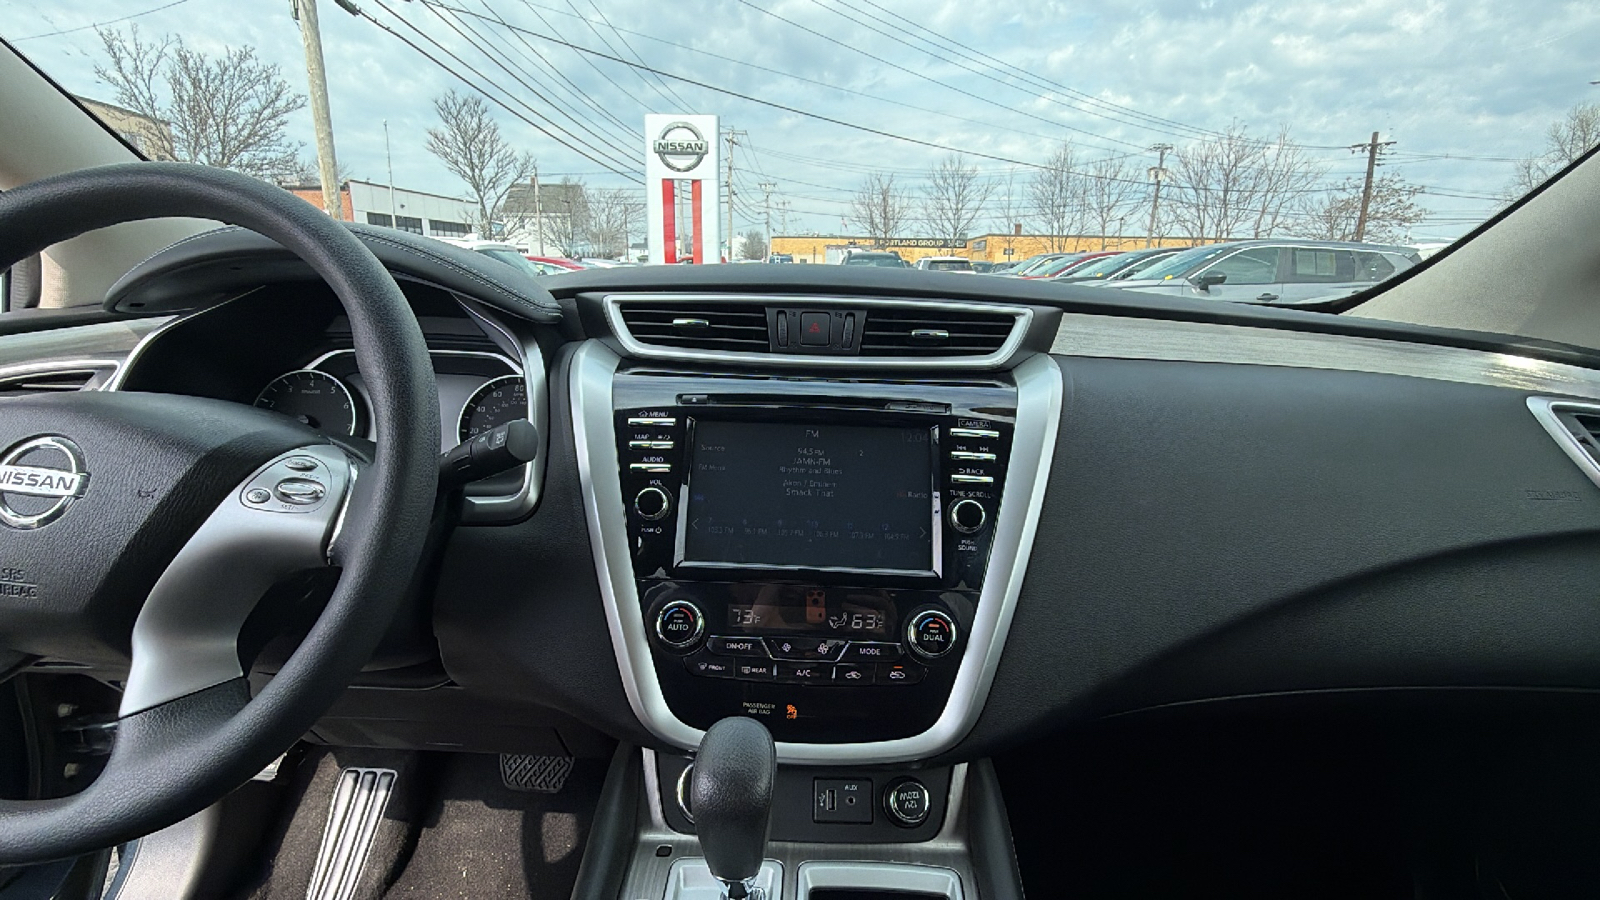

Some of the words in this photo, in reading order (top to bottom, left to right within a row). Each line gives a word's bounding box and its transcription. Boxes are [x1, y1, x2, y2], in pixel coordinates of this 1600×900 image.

[658, 142, 703, 151] NISSAN
[959, 420, 989, 428] CAMERA
[805, 429, 819, 438] FM
[966, 468, 985, 476] BACK
[1, 567, 26, 580] SRS
[667, 623, 689, 631] AUTO
[923, 633, 945, 642] DUAL
[859, 647, 881, 656] MODE
[796, 669, 811, 678] A/C
[742, 701, 776, 709] PASSENGER
[899, 791, 921, 800] 120W
[904, 800, 918, 809] 12V
